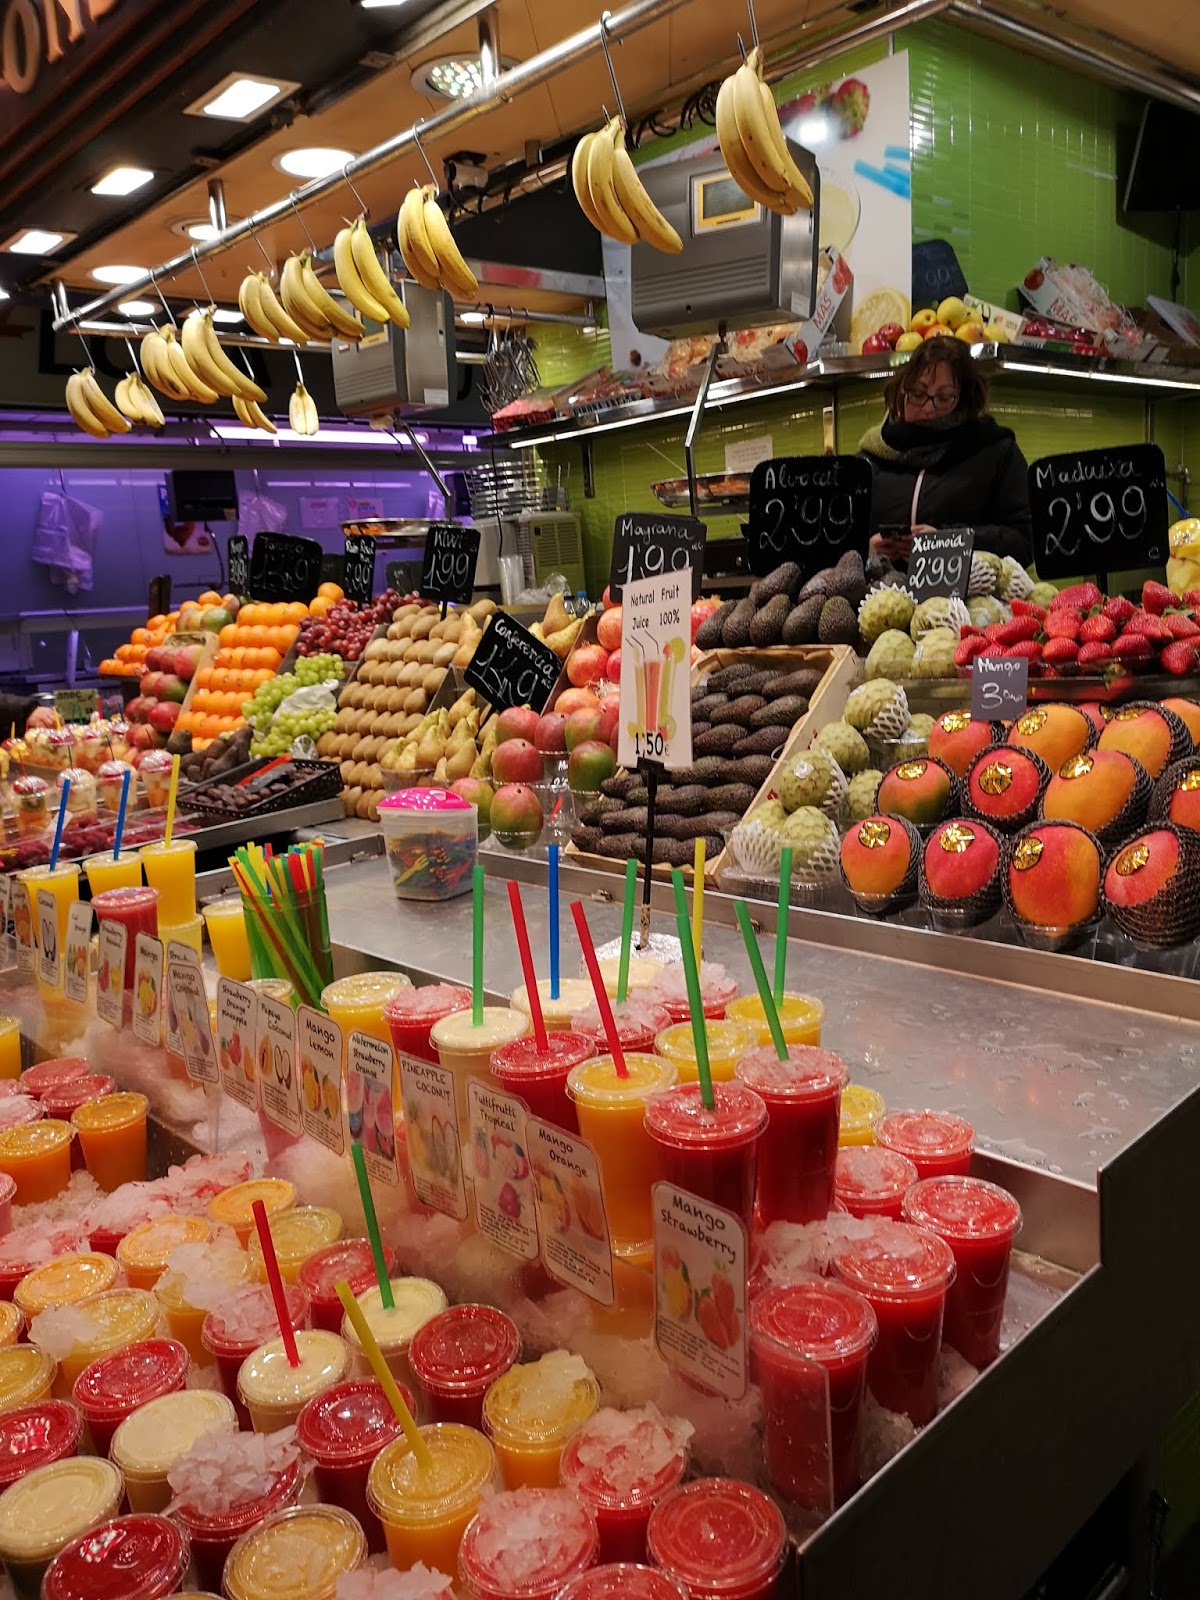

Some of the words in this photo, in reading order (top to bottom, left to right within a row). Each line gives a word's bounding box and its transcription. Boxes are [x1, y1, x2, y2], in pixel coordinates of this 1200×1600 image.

[1036, 456, 1142, 488] Maduixa
[1045, 485, 1148, 555] 2'99
[909, 555, 962, 588] 2'99
[631, 588, 655, 608] Natural
[661, 584, 680, 601] Fruit
[632, 615, 650, 630] Juice
[659, 608, 680, 626] 100%
[978, 657, 1021, 678] Mango
[981, 681, 1003, 709] 3
[172, 969, 196, 985] Mango
[222, 984, 252, 1009] Strawberry
[226, 998, 246, 1015] Orange
[261, 1003, 282, 1024] Papaya
[267, 1021, 293, 1041] Coconut
[305, 1018, 336, 1045] Mango
[309, 1036, 336, 1060] Lemon
[352, 1034, 389, 1056] Watermelon
[353, 1047, 386, 1074] Strawberry
[355, 1062, 378, 1079] Orange
[401, 1060, 447, 1085] PINEAPPLE
[416, 1081, 452, 1101] COCONUT
[473, 1090, 517, 1118] Tuttifrutti
[480, 1109, 516, 1133] Tropical
[538, 1128, 574, 1154] Mango
[549, 1149, 588, 1178] Orange
[672, 1194, 726, 1231] Mango
[661, 1209, 736, 1264] Strawberry
